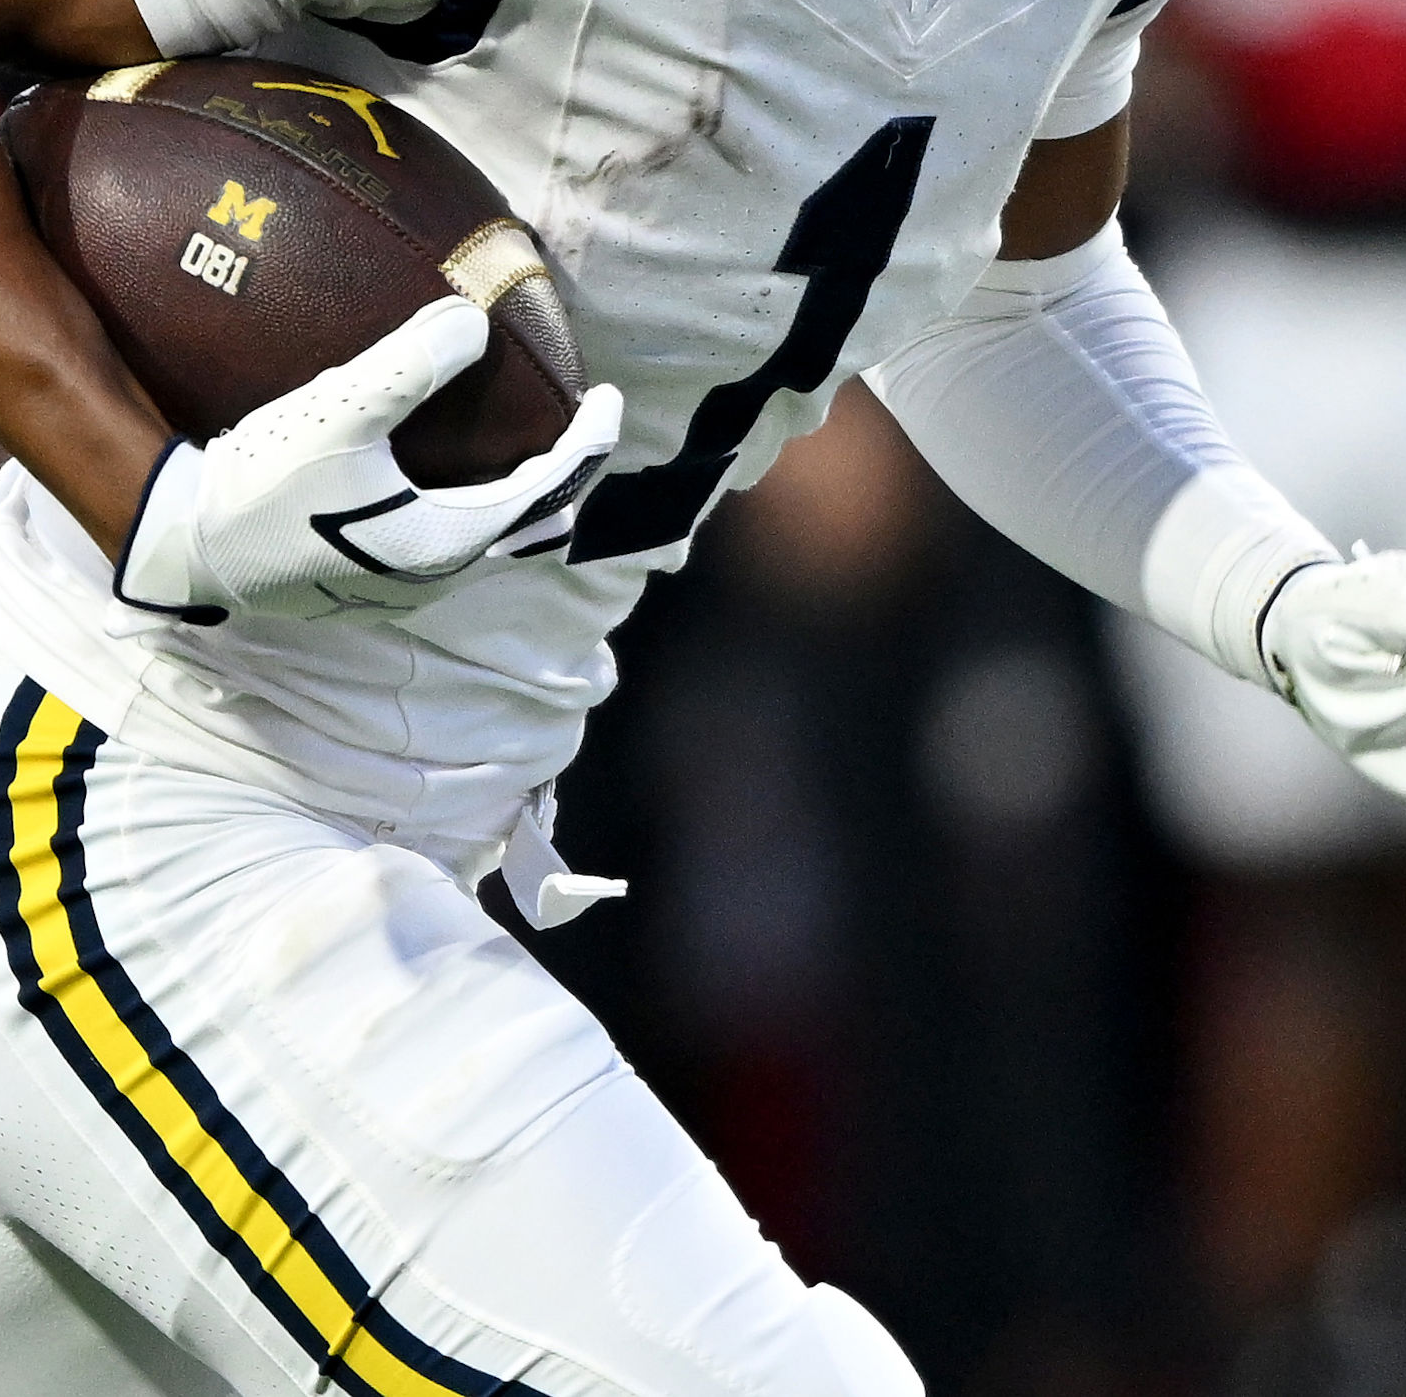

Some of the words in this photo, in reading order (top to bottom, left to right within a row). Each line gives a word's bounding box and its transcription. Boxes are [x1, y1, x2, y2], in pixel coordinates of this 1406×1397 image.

[206, 179, 277, 242] M
[179, 231, 249, 296] 081
[566, 115, 937, 566] 1
